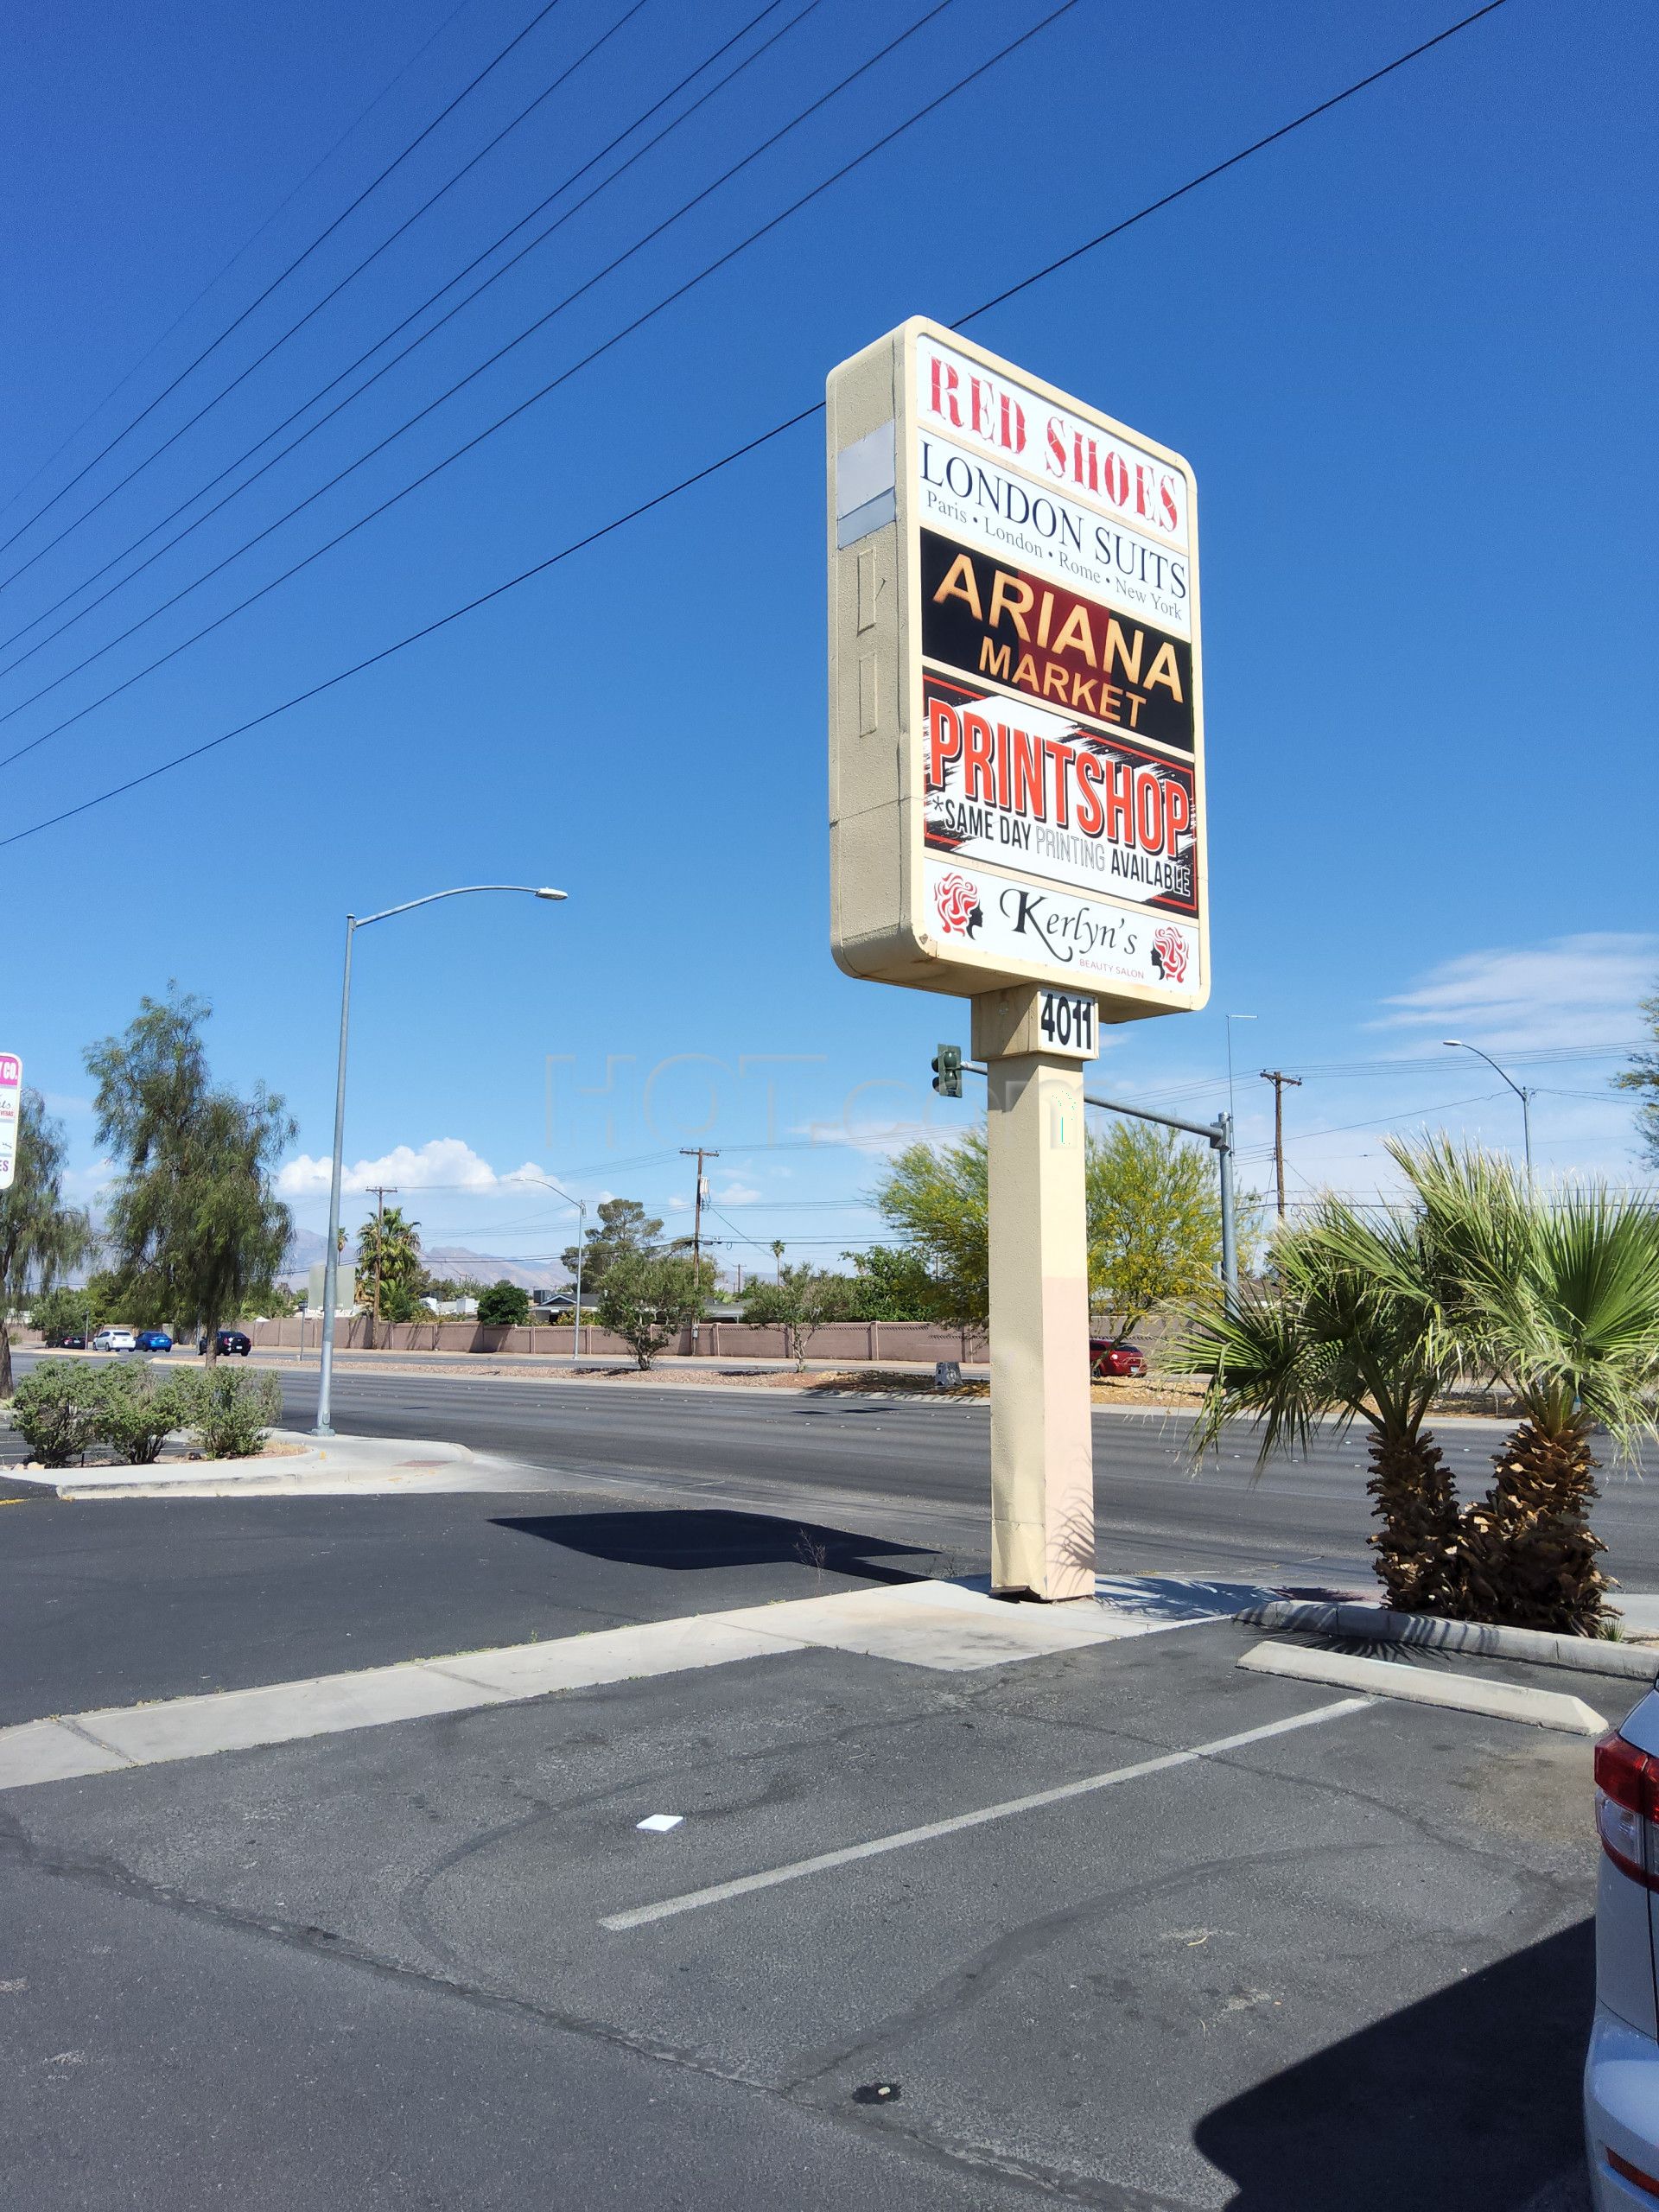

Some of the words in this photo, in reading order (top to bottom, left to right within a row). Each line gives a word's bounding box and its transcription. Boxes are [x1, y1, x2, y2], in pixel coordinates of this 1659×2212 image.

[928, 353, 1027, 454] RED
[1046, 416, 1179, 532] SHOES
[919, 440, 1084, 553] LONDON
[1095, 526, 1186, 599] SUITS
[926, 489, 967, 524] Paris
[983, 516, 1043, 558] London
[1058, 550, 1101, 583] Rome
[1114, 576, 1147, 604] New
[1151, 593, 1183, 620] York
[932, 553, 1184, 703] ARIANA
[979, 636, 1147, 728] MARKET
[928, 697, 1190, 860] PRINTSHOP
[1000, 814, 1032, 851] DAY
[1035, 825, 1106, 872] PRINTING
[1111, 849, 1191, 897] AVAILABLE
[999, 888, 1138, 963] Kerlyn's
[1079, 958, 1113, 973] BEAUTY
[1116, 966, 1145, 979] SALON
[1041, 994, 1092, 1050] 4011
